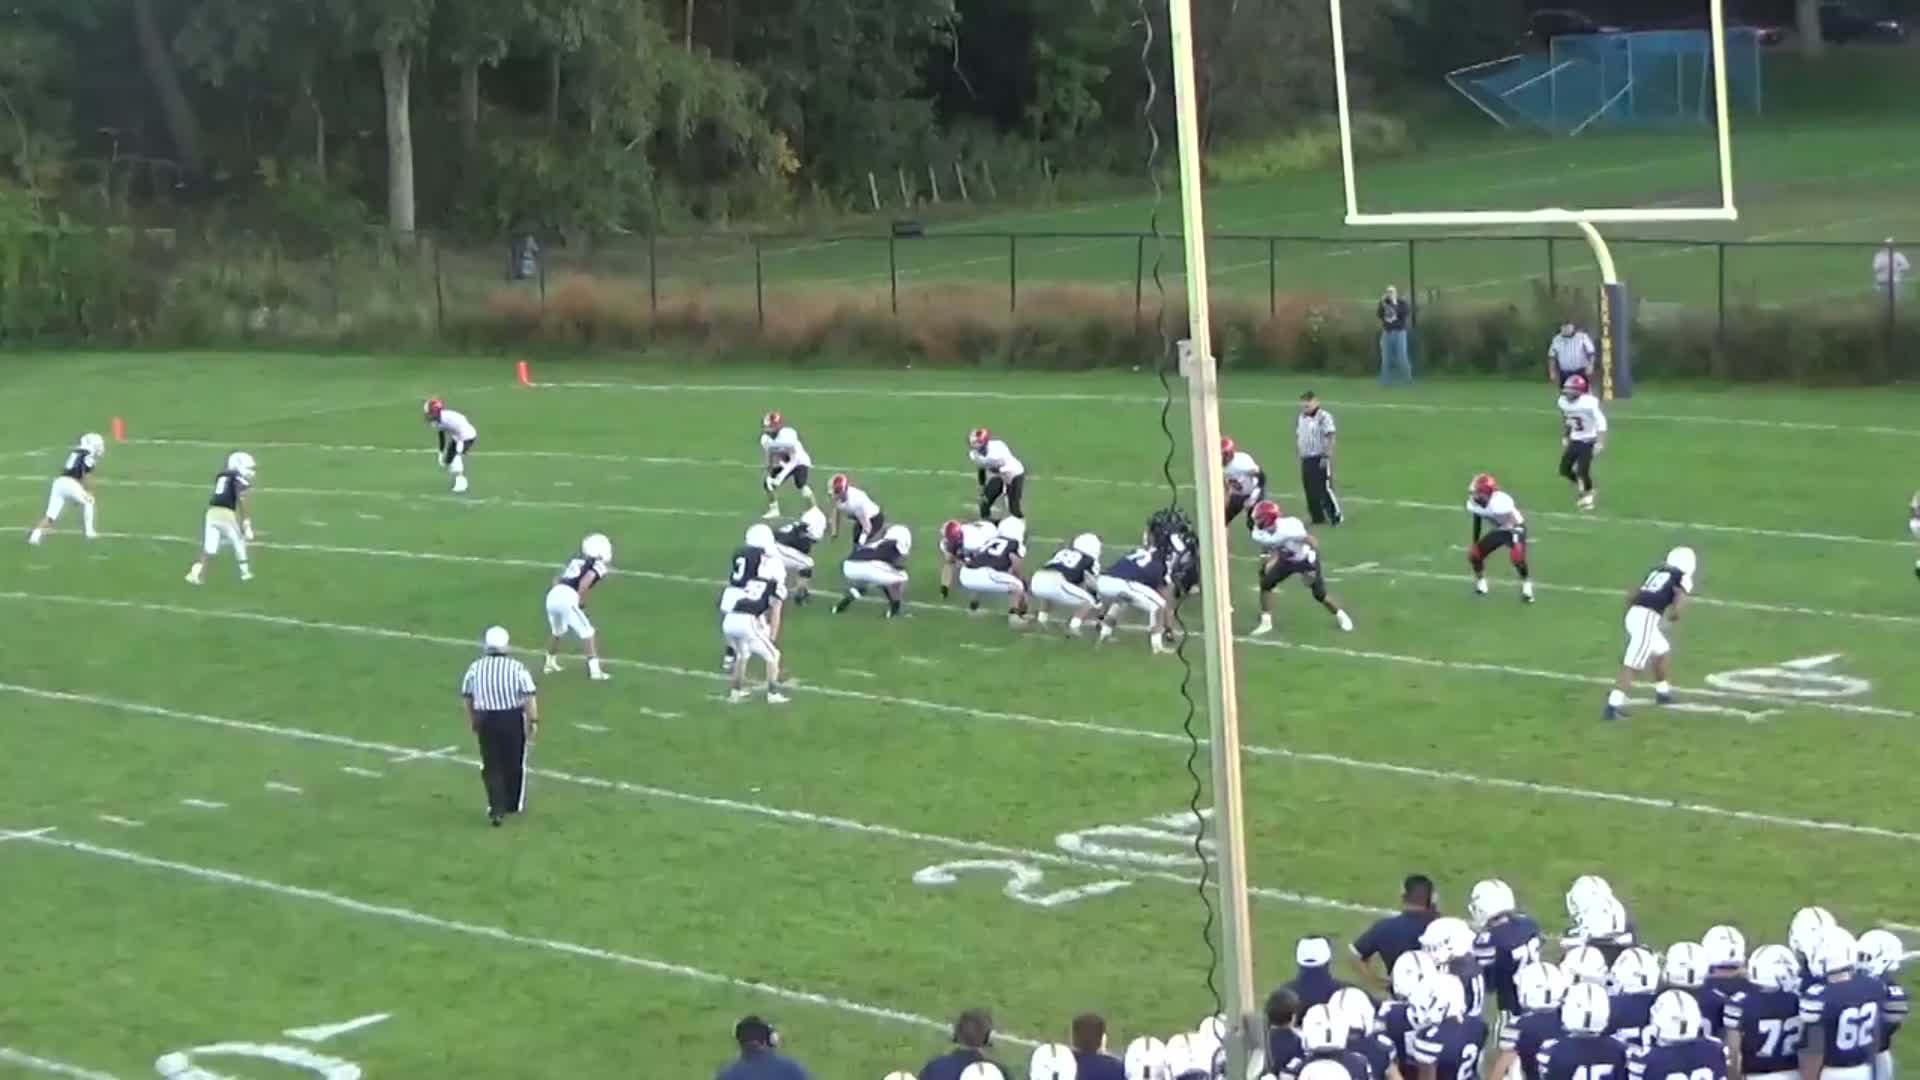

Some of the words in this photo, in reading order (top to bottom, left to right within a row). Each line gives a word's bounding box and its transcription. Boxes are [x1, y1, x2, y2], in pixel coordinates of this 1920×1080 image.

[1755, 1018, 1803, 1057] 72
[1836, 1001, 1878, 1051] 62
[1456, 1043, 1479, 1080] 2
